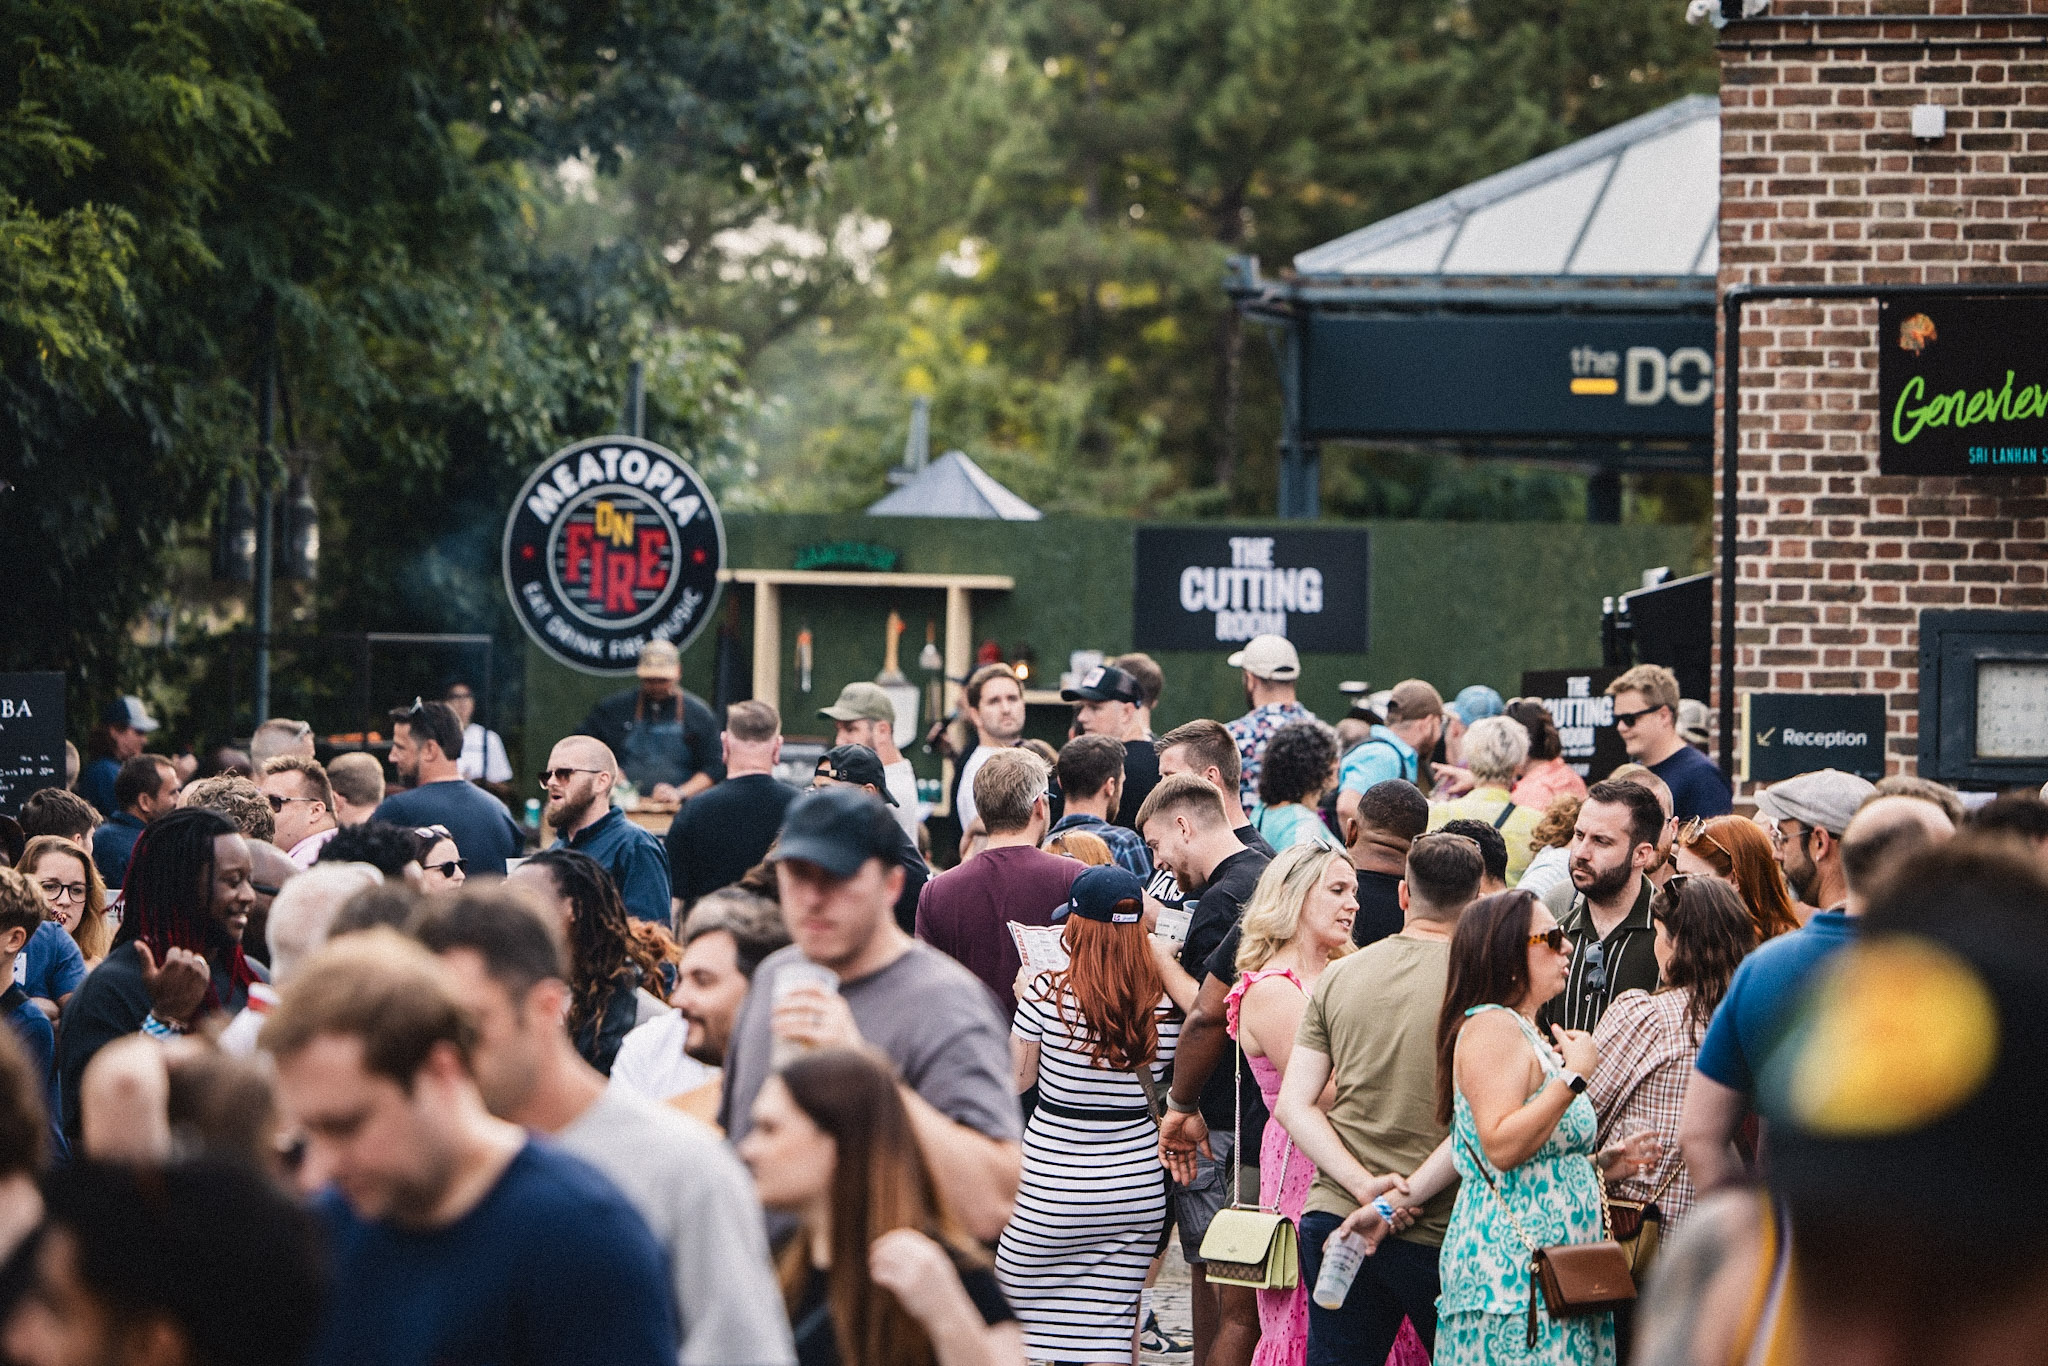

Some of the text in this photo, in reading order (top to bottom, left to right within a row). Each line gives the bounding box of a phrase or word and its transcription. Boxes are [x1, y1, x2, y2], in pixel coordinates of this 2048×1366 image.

[1570, 344, 1620, 377] the
[1969, 446, 1988, 465] SRI
[527, 447, 701, 525] MEATOPIA
[595, 500, 635, 547] ON
[564, 522, 668, 613] FIRE
[1229, 536, 1275, 568] THE
[1179, 565, 1324, 613] CUTTING
[545, 614, 605, 659] DRINK
[1566, 675, 1591, 697] THE
[1782, 727, 1868, 749] Reception
